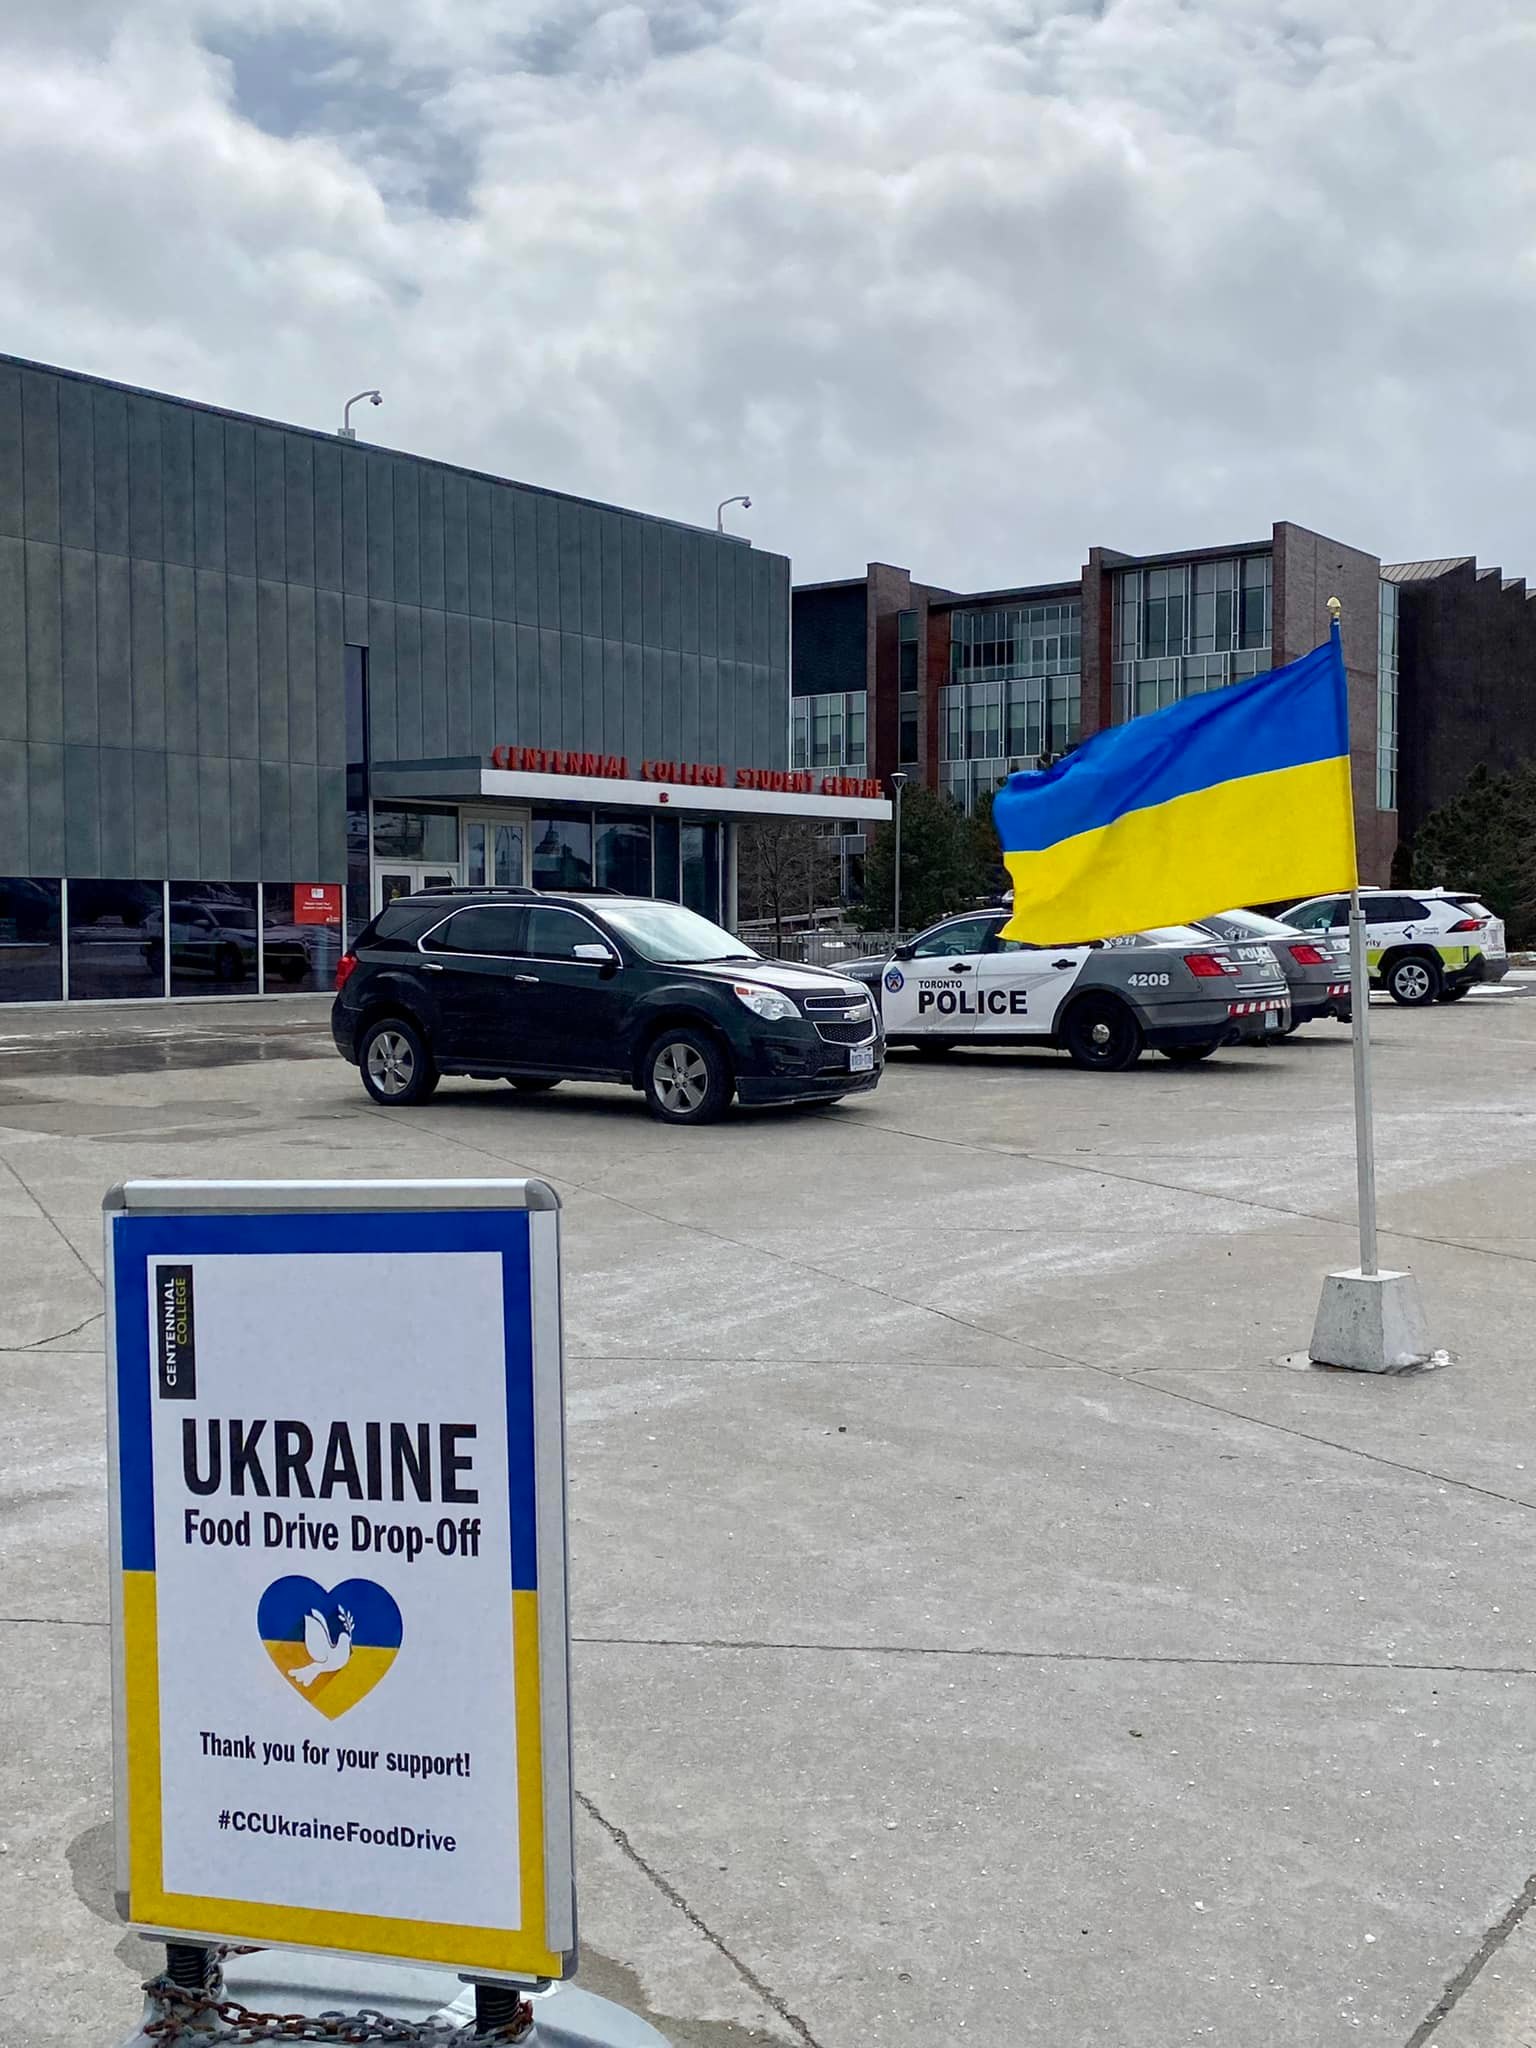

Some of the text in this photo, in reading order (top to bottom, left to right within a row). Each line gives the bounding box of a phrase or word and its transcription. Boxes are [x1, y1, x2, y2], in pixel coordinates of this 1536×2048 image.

[492, 746, 882, 799] CENTENNIAL COLLEGE STUDENT CENTRE
[918, 980, 962, 989] TORONTO
[918, 990, 1028, 1015] POLICE
[1128, 973, 1170, 987] 4208
[164, 1278, 177, 1386] CENTENNIAL
[175, 1278, 187, 1345] COLLEGE
[182, 1418, 479, 1504] UKRAINE
[184, 1508, 481, 1563] Food Drive Drop-Off
[200, 1731, 471, 1779] Thank you for your support!
[218, 1809, 457, 1852] #CCUkraineFoodDrive
